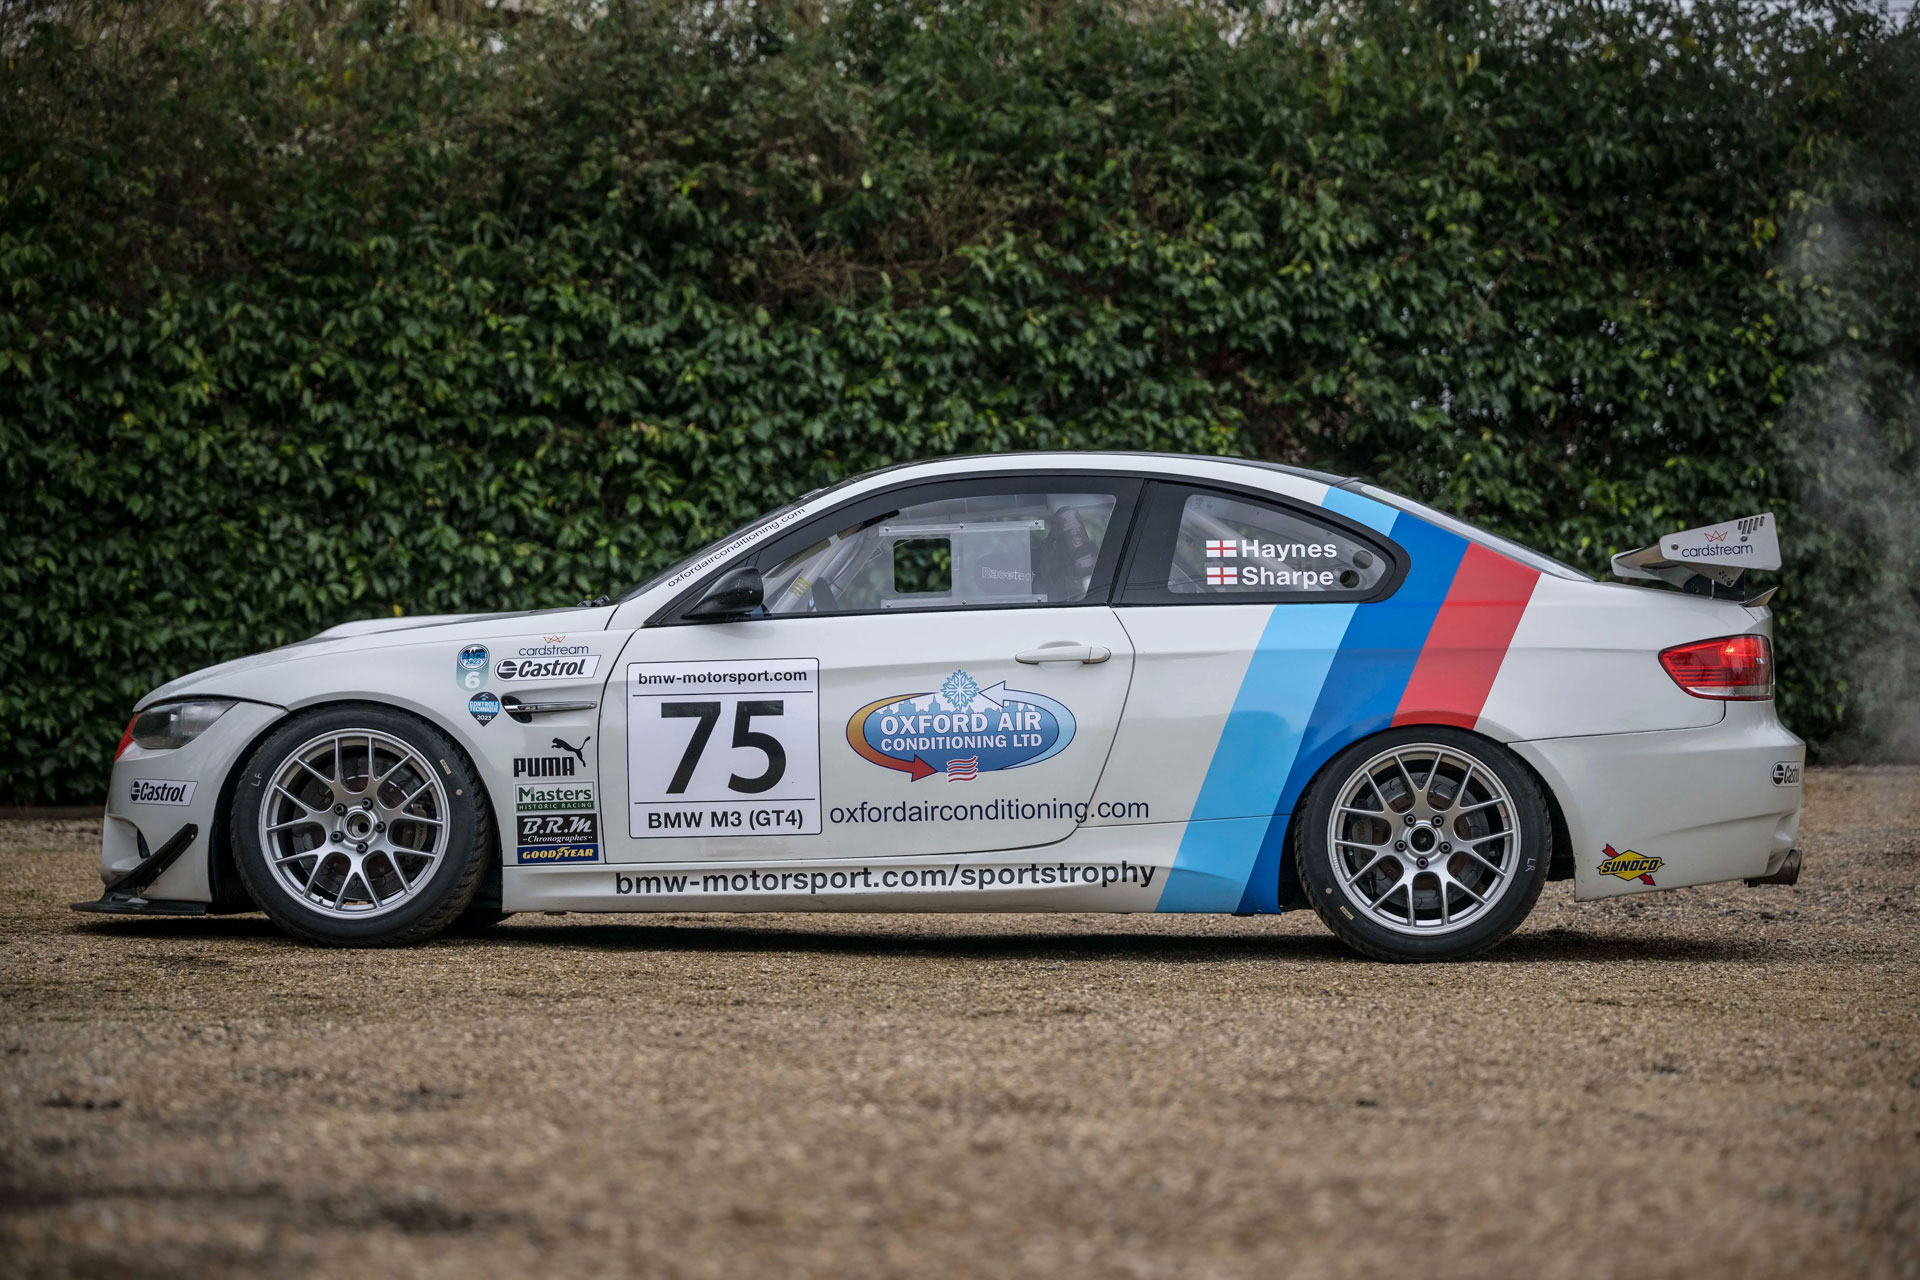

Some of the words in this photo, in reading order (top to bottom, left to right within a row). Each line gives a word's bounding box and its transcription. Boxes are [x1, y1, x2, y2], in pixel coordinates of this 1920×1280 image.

[667, 507, 806, 588] oxfordairconditioning.com
[1241, 539, 1338, 562] Haynes
[1681, 543, 1754, 558] cardstream
[1241, 566, 1334, 590] Sharpe
[462, 652, 486, 660] RACE
[518, 645, 589, 656] cardstream
[518, 658, 586, 678] Castrol
[638, 669, 808, 685] bmw-motorsport.com
[464, 671, 481, 689] 6
[880, 712, 988, 736] OXFORD
[997, 711, 1042, 732] AIR
[660, 699, 787, 795] 75
[880, 734, 1007, 752] CONDITIONING
[1013, 732, 1042, 748] LTD
[513, 756, 575, 777] PUMA
[139, 782, 187, 802] Castrol
[518, 787, 592, 802] Masters
[647, 811, 703, 829] BMW
[710, 810, 743, 828] M3
[749, 809, 804, 831] (GT4)
[829, 798, 1150, 824] oxfordairconditioning.com
[522, 846, 594, 860] GOODYEAR
[1602, 859, 1660, 873] SUNOCO
[615, 860, 1156, 895] bmw-motorsport.com/sportstrophy
